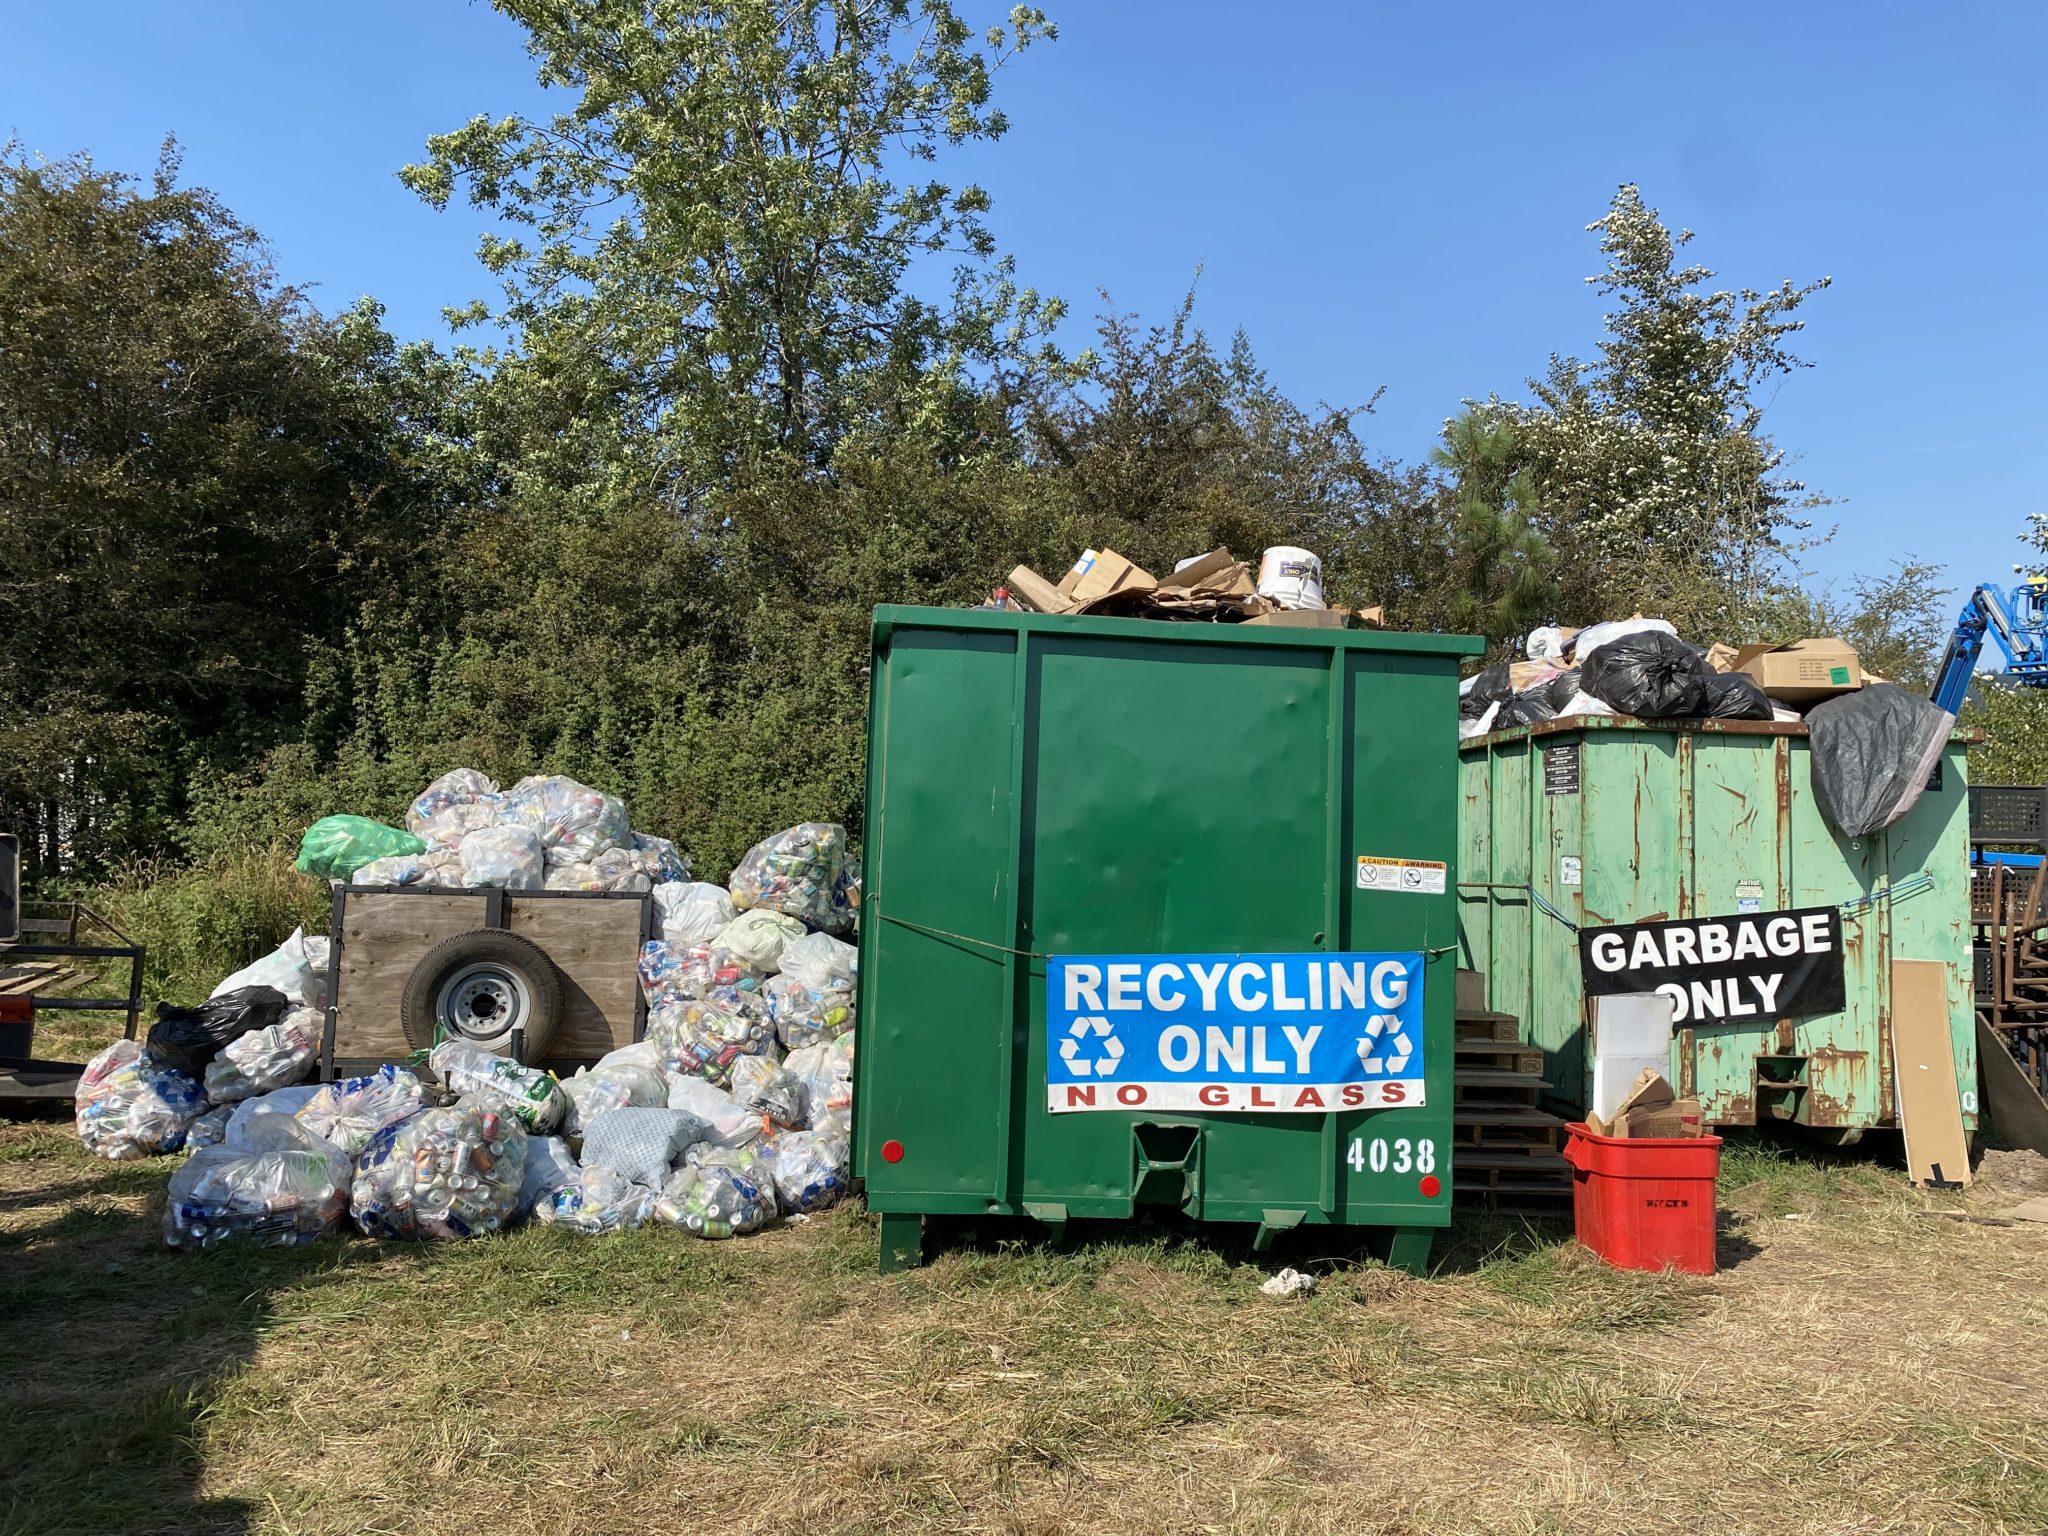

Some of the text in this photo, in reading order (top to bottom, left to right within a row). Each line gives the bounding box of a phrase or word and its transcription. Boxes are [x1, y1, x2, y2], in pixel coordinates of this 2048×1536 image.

[1367, 858, 1399, 866] CAUTION
[1591, 914, 1832, 972] GARBAGE
[1064, 961, 1409, 1012] RECYCLING
[1654, 973, 1784, 1023] ONLY
[1158, 1024, 1324, 1074] ONLY
[1067, 1082, 1407, 1107] NO GLASS
[1347, 1137, 1436, 1173] 4038
